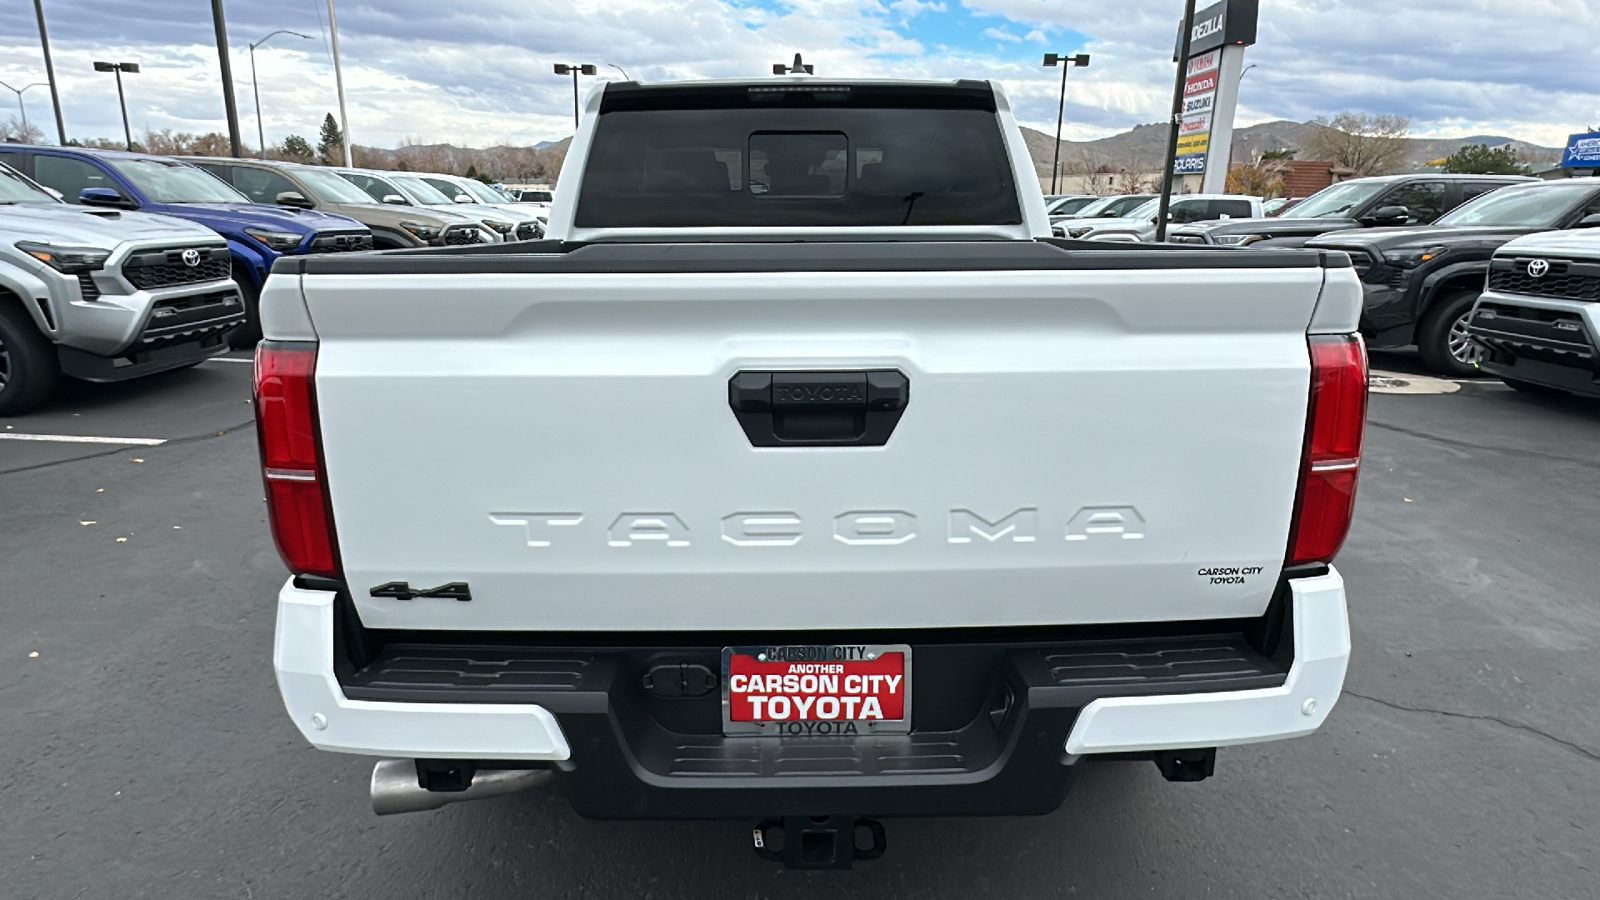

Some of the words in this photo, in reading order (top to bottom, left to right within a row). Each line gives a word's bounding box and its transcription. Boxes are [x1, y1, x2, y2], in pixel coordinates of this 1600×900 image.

[1186, 78, 1214, 94] HONDA
[1186, 96, 1211, 112] SUZUKI
[776, 385, 863, 401] TOYOTA
[489, 505, 1146, 547] TACOMA
[1198, 568, 1239, 576] CARSON
[1241, 567, 1264, 575] CITY
[767, 647, 828, 661] CARSON
[834, 646, 866, 661] CITY
[788, 664, 844, 674] ANOTHER
[730, 674, 838, 693] CARSON
[844, 675, 902, 694] CITY
[747, 695, 884, 720] TOYOTA
[776, 721, 858, 735] TOYOTA
